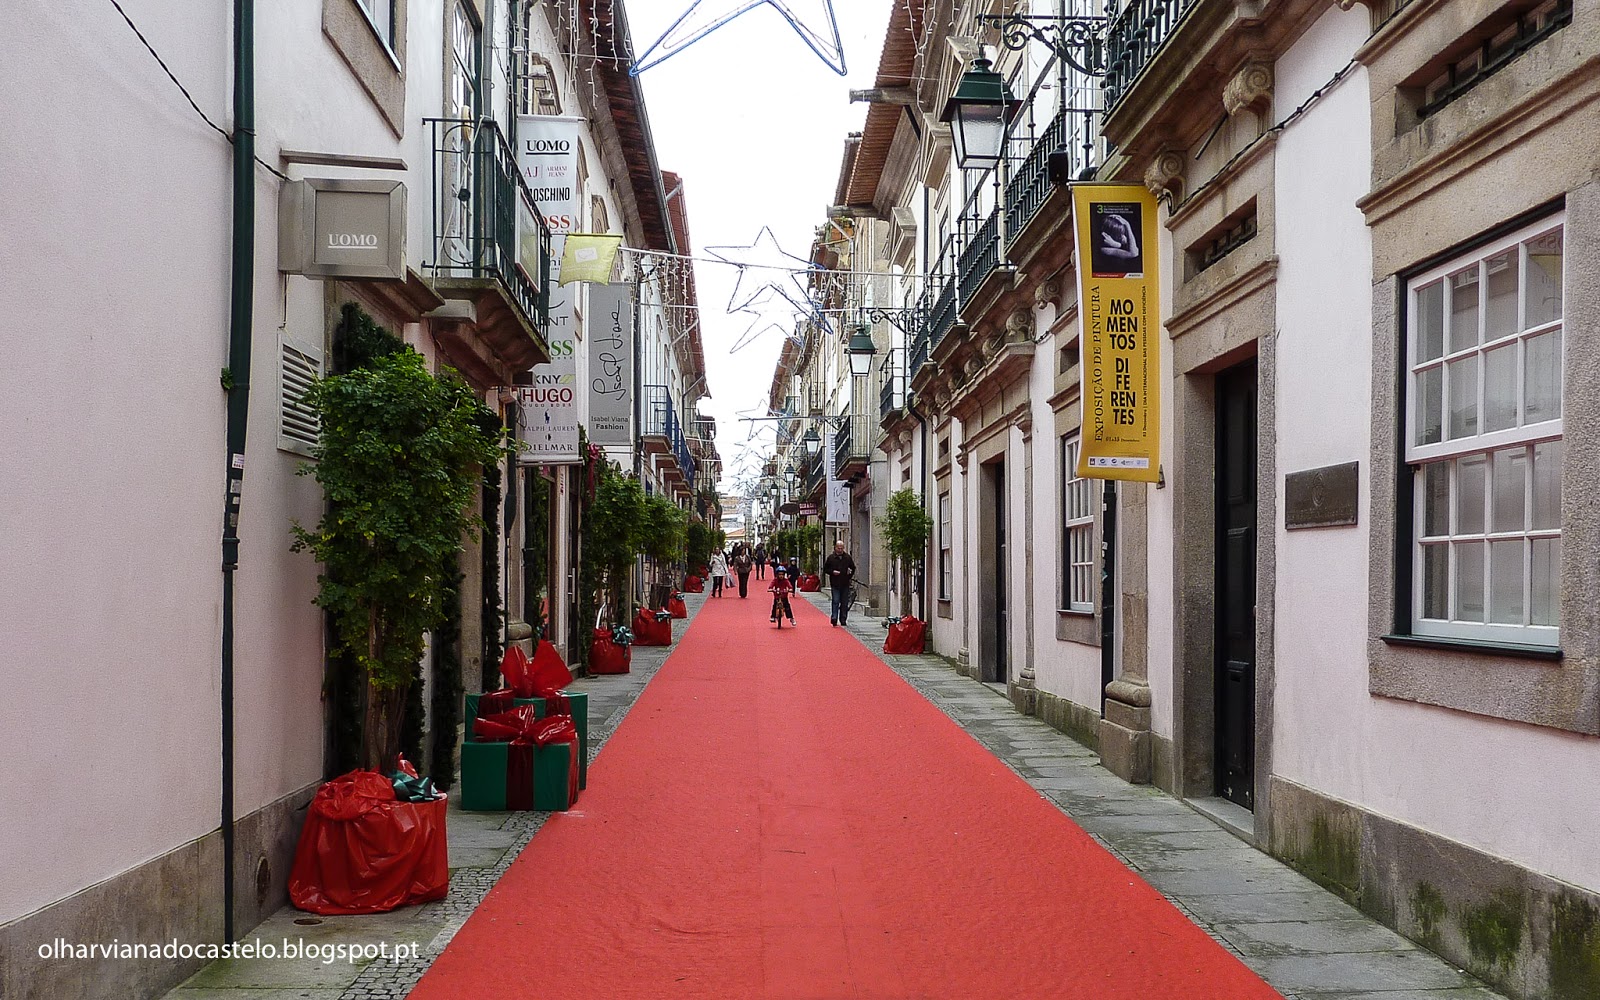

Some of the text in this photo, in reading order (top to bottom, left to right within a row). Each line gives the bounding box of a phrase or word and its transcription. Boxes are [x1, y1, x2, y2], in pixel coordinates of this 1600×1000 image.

[525, 139, 570, 152] UOMO
[524, 166, 540, 178] AJ
[1097, 204, 1104, 214] 3
[328, 233, 378, 247] UOMO
[1110, 299, 1134, 315] MO
[548, 316, 569, 327] NT
[1106, 316, 1138, 333] MEN
[1109, 333, 1136, 350] TOS
[1091, 285, 1104, 442] EXPOSIÇÃO DE PINTURA
[1115, 357, 1129, 373] DI
[536, 375, 561, 384] KNY
[1116, 374, 1130, 390] FE
[522, 388, 573, 402] HUGO
[1110, 391, 1136, 407] REN
[1113, 408, 1135, 425] TES
